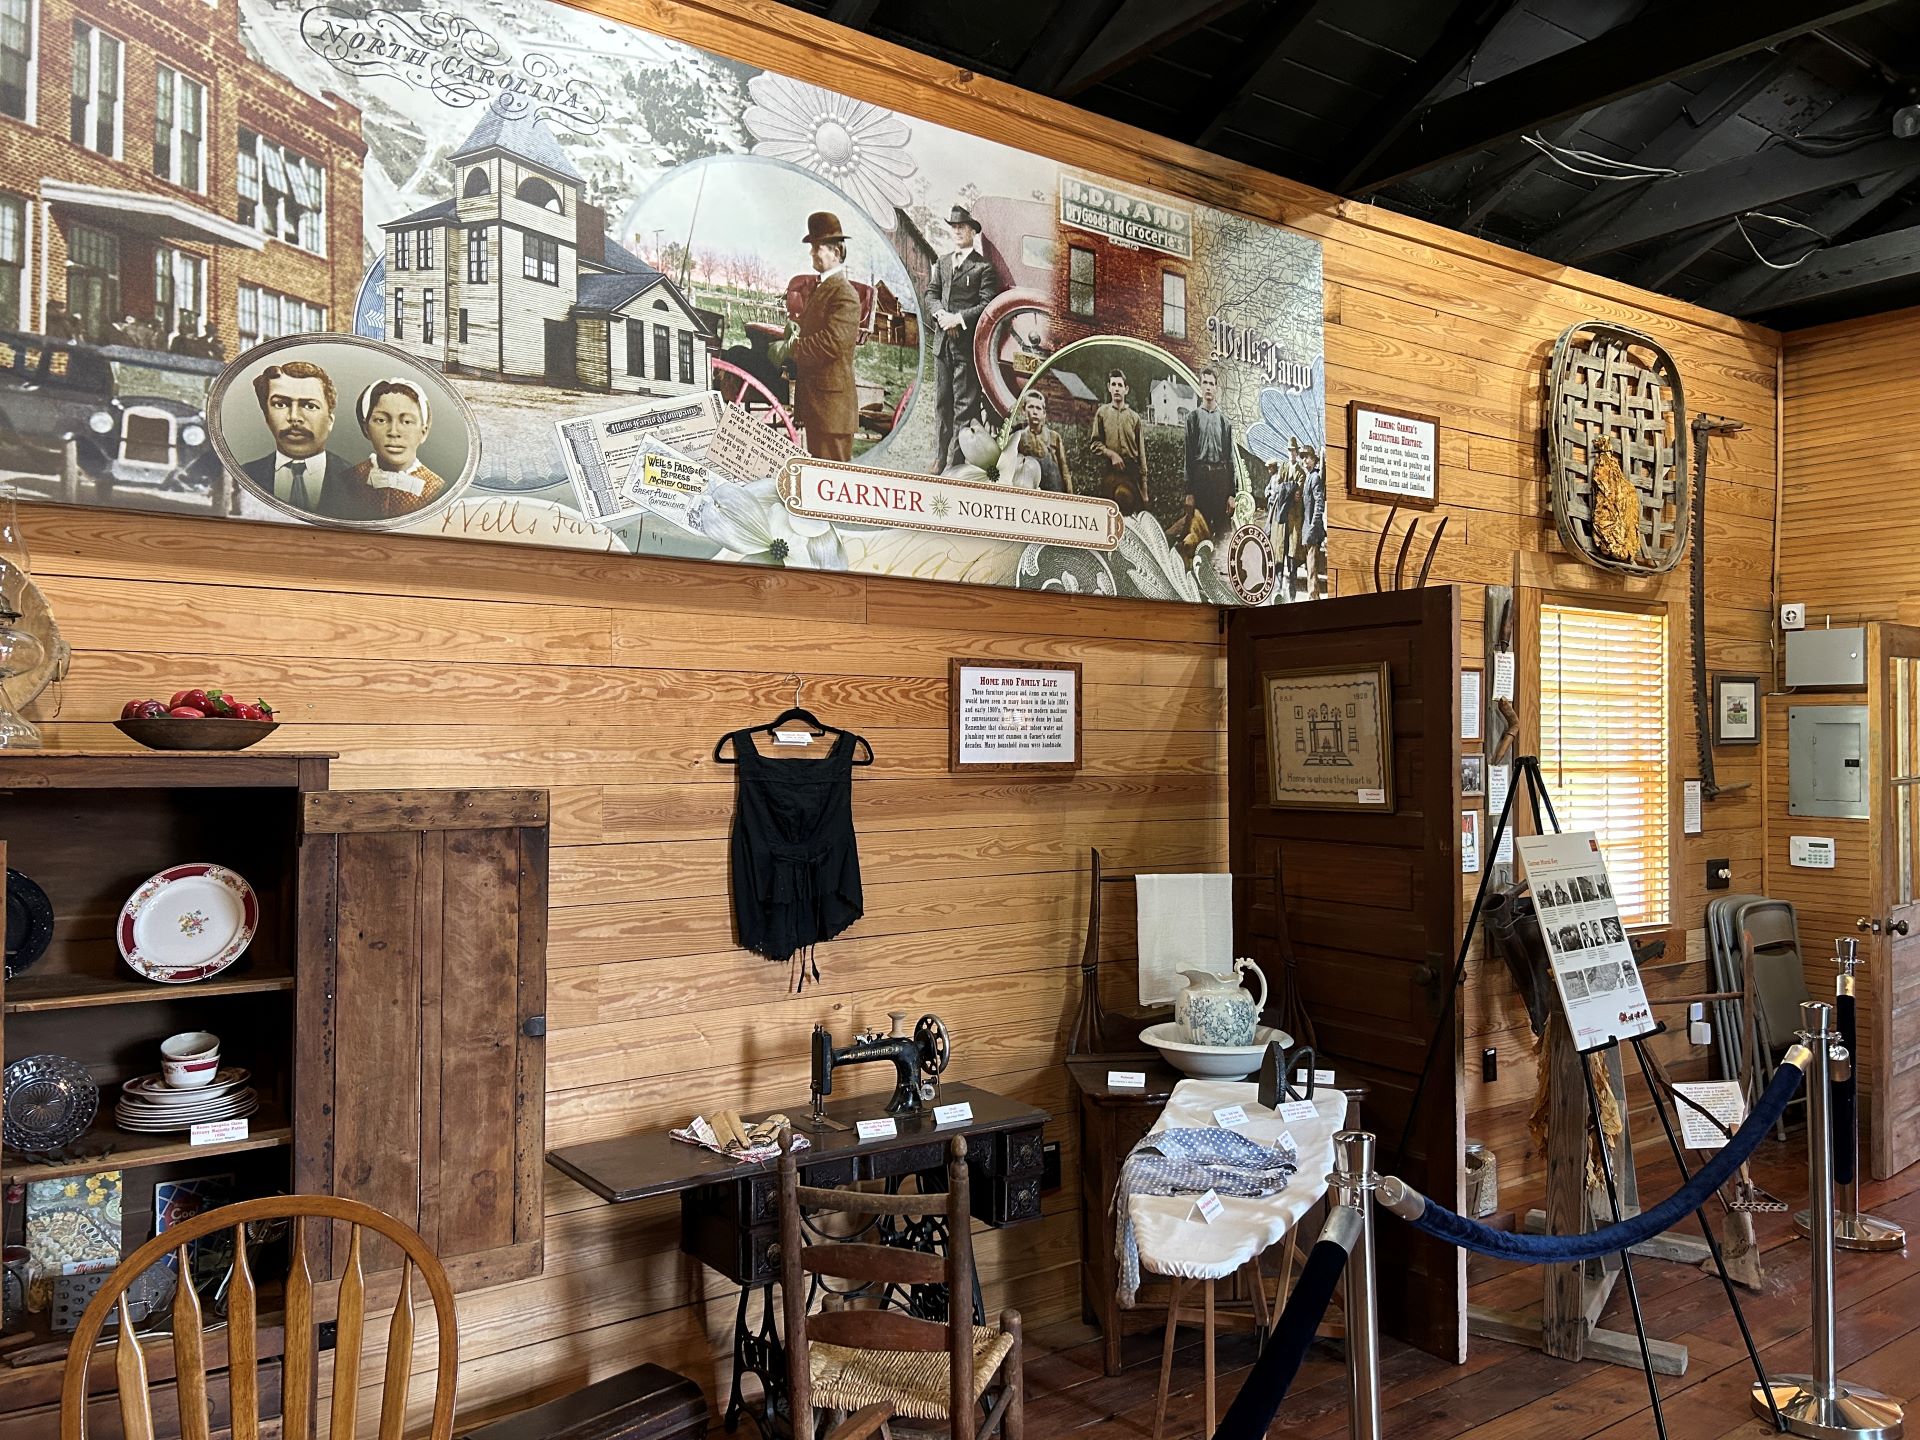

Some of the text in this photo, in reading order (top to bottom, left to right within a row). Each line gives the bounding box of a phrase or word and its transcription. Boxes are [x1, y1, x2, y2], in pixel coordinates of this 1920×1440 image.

[312, 19, 430, 68] NORTH
[1066, 202, 1081, 223] Dry
[1082, 208, 1107, 232] Goods
[1109, 217, 1125, 235] and
[1206, 316, 1311, 395] Wells Fargo
[729, 404, 744, 416] SOLD
[757, 421, 778, 438] NEARLY
[779, 436, 789, 446] ALL
[731, 413, 744, 424] CIES
[762, 434, 783, 449] UNITED
[738, 425, 751, 437] VERY
[753, 435, 765, 445] LOW
[1361, 442, 1373, 451] Crops
[1374, 445, 1382, 453] such
[648, 456, 672, 469] WELLS
[674, 462, 695, 474] FARGO
[1393, 459, 1401, 467] well
[1409, 462, 1422, 471] poultry
[661, 469, 690, 481] EXPRESS
[1359, 465, 1370, 473] other
[1427, 474, 1430, 482] of
[648, 476, 702, 492] MONEY ORDERS
[1389, 479, 1400, 488] farms
[632, 486, 677, 500] GREAT PUBLIC
[648, 496, 685, 509] CONVENIENCE
[817, 479, 1100, 532] GARNER NORTH CAROLINA
[440, 496, 538, 534] Wells
[1231, 531, 1244, 549] TEN
[980, 677, 1058, 687] HOME AND FAMILY LIFE
[965, 733, 984, 741] plumbing
[984, 742, 996, 750] Many
[1288, 773, 1306, 782] Home
[1314, 776, 1332, 784] where
[1334, 776, 1345, 784] the
[1346, 776, 1364, 785] heart
